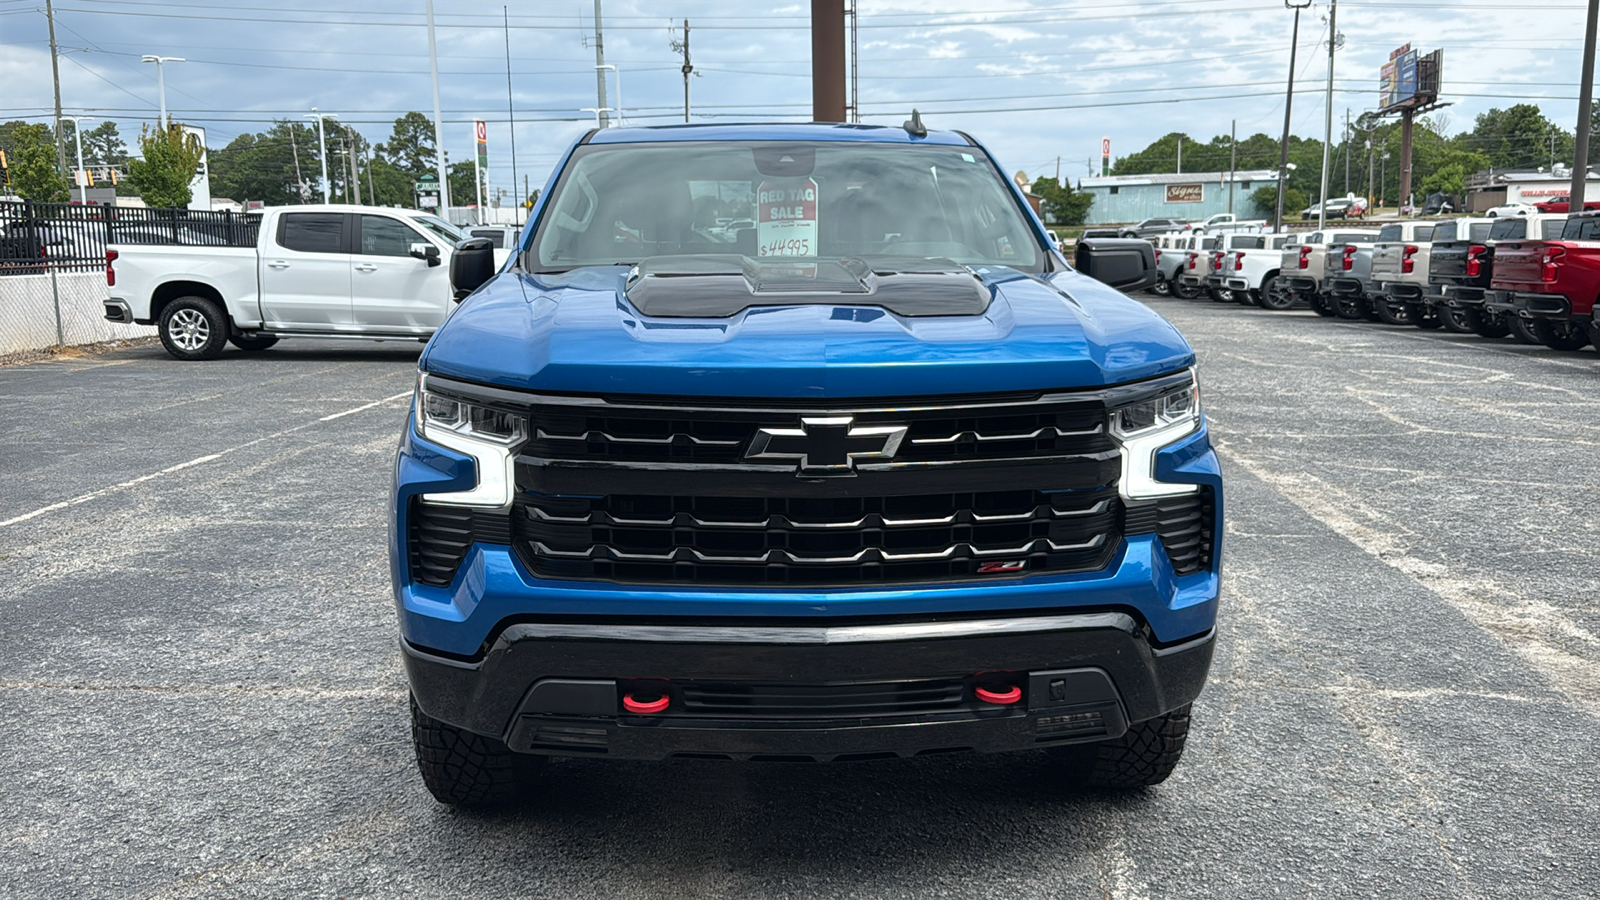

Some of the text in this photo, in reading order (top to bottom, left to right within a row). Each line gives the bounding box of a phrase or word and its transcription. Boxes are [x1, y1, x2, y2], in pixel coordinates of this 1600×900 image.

[760, 188, 815, 204] RED TAG
[770, 206, 804, 220] SALE
[977, 560, 1026, 573] Z71
